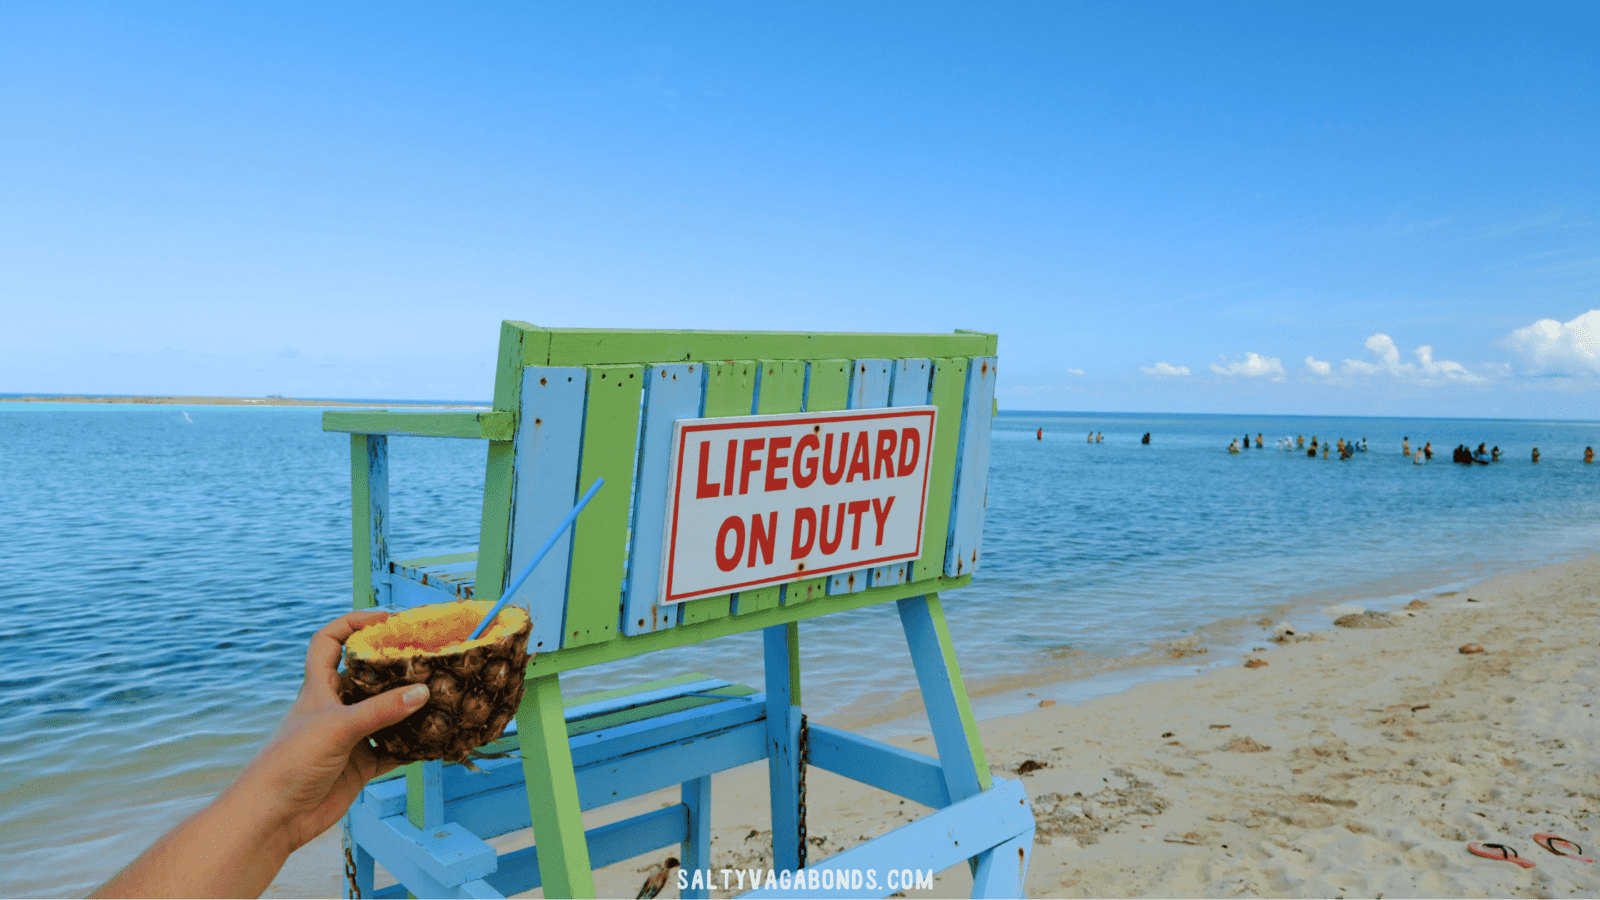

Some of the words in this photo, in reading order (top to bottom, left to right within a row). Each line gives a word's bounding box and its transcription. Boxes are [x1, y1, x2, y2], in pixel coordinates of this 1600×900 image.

[696, 427, 920, 499] LIFEGUARD
[715, 511, 778, 572] ON
[790, 496, 896, 560] DUTY
